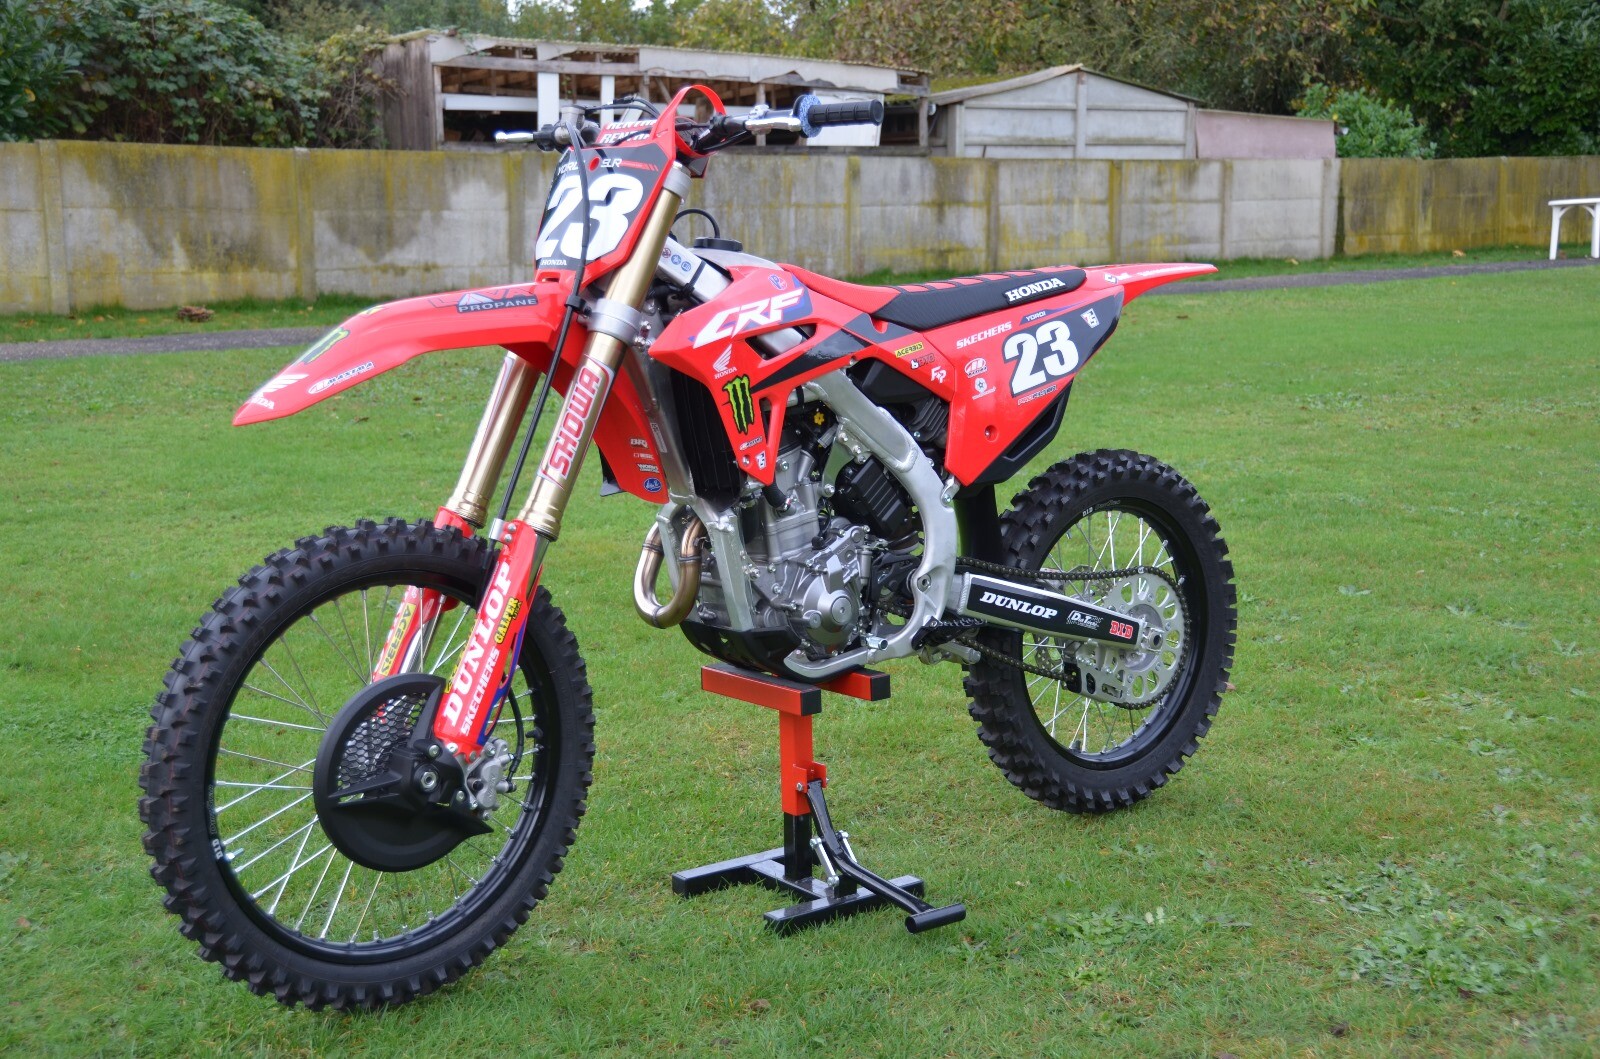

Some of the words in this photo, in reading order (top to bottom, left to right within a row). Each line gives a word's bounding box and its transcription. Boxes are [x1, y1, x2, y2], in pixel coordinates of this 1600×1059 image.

[535, 173, 643, 260] 23
[458, 298, 538, 313] PROPANE
[1005, 277, 1066, 302] HONDA
[692, 287, 804, 349] CRF
[956, 320, 1013, 349] SKECHERS
[714, 366, 738, 380] HONDA
[896, 343, 923, 357] ACERBIS
[1004, 320, 1079, 394] 23
[548, 365, 602, 480] SHOWA
[494, 597, 519, 644] GALFER
[979, 591, 1058, 619] DUNLOP
[379, 604, 416, 674] ACERBIS
[443, 561, 512, 727] DUNLOP
[460, 647, 500, 737] SKECHERS
